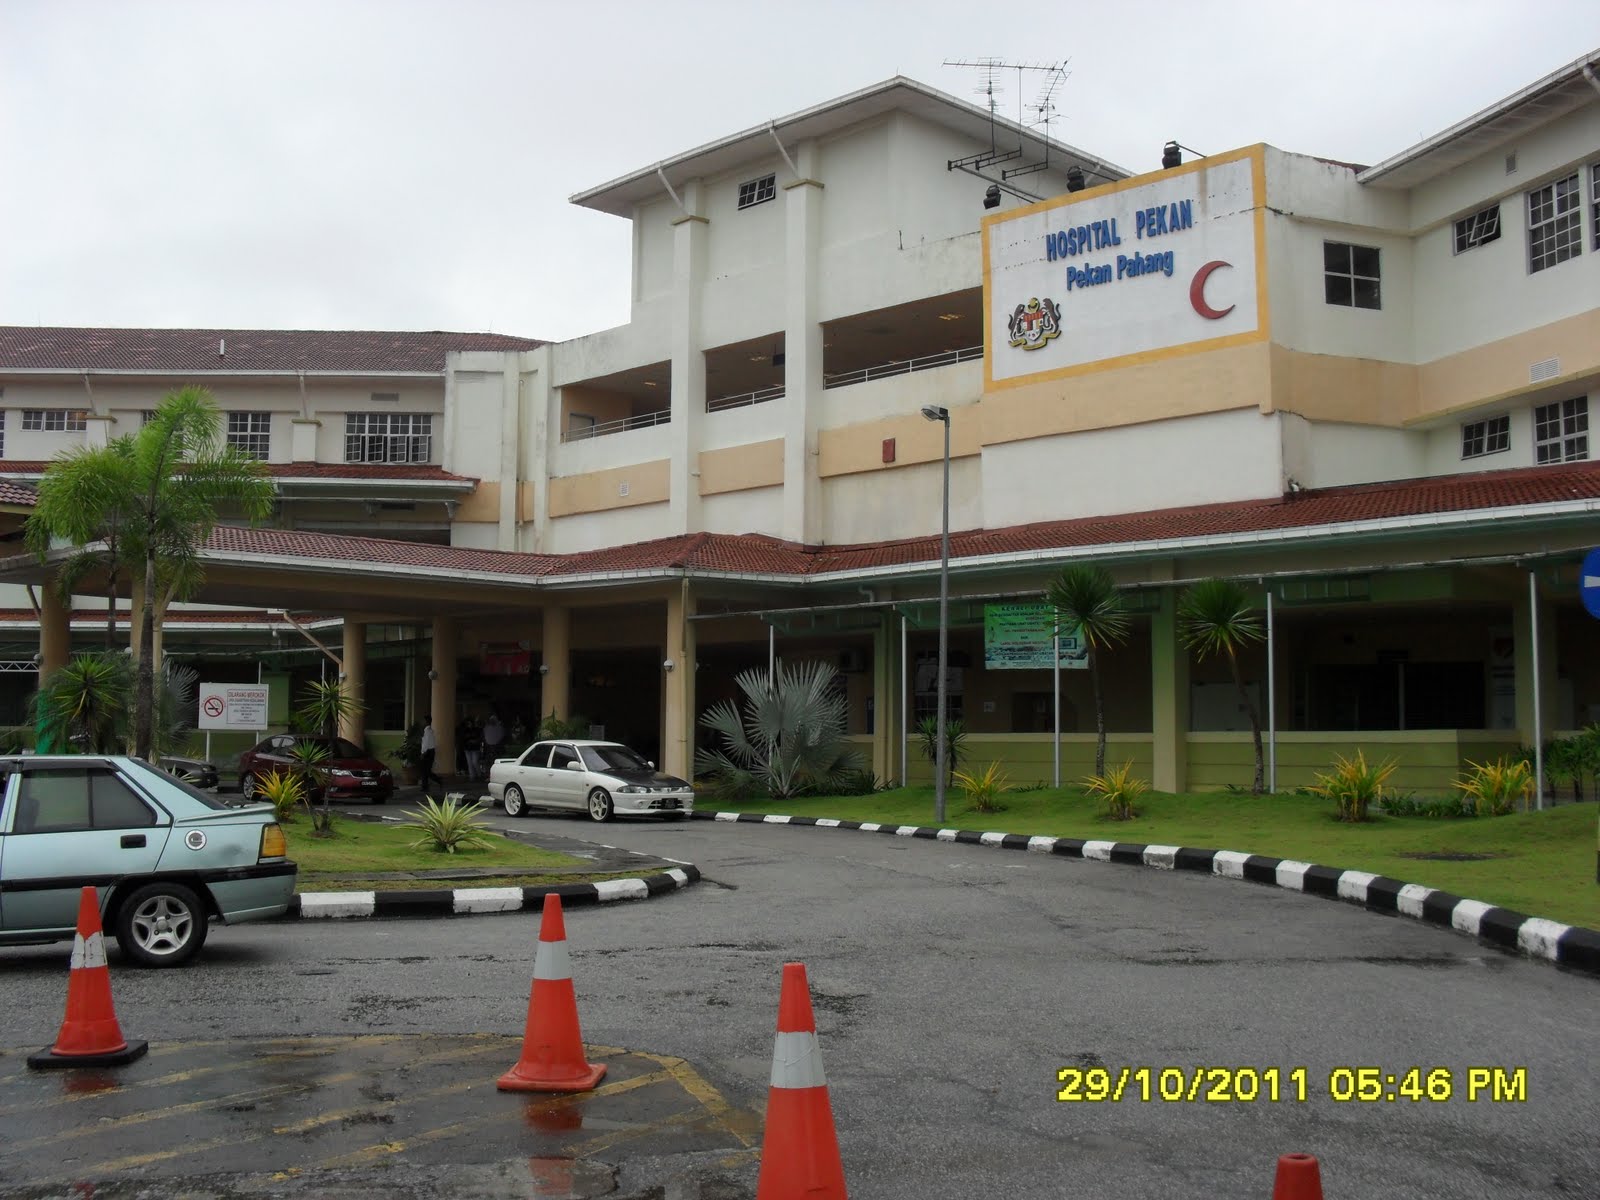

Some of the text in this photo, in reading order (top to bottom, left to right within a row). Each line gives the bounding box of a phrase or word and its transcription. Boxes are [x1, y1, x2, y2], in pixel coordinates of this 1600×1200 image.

[1046, 199, 1192, 262] HOSPITAL PEKAN
[1066, 250, 1174, 291] Pekan Pahang
